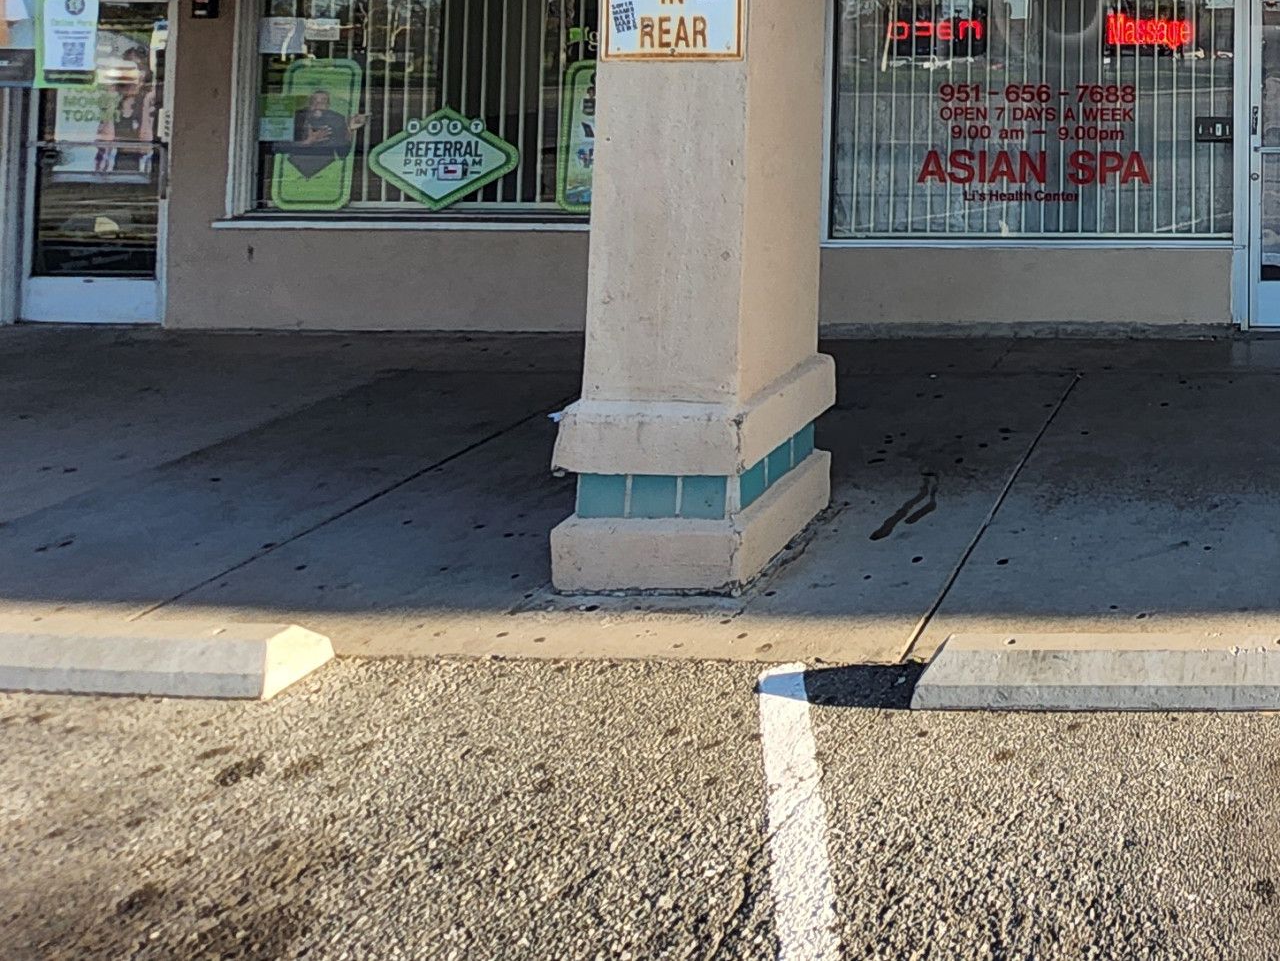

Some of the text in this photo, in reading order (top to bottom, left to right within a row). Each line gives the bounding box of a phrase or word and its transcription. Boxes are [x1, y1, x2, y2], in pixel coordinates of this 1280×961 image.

[639, 16, 708, 48] REAR
[1107, 13, 1192, 50] Massage
[939, 107, 1135, 121] OPEN 7 DAYS A WEEK
[405, 140, 483, 157] REFERRAL
[415, 168, 428, 176] IN
[917, 149, 1152, 185] ASIAN SPA
[989, 190, 1031, 201] Health
[1035, 190, 1079, 201] Center
